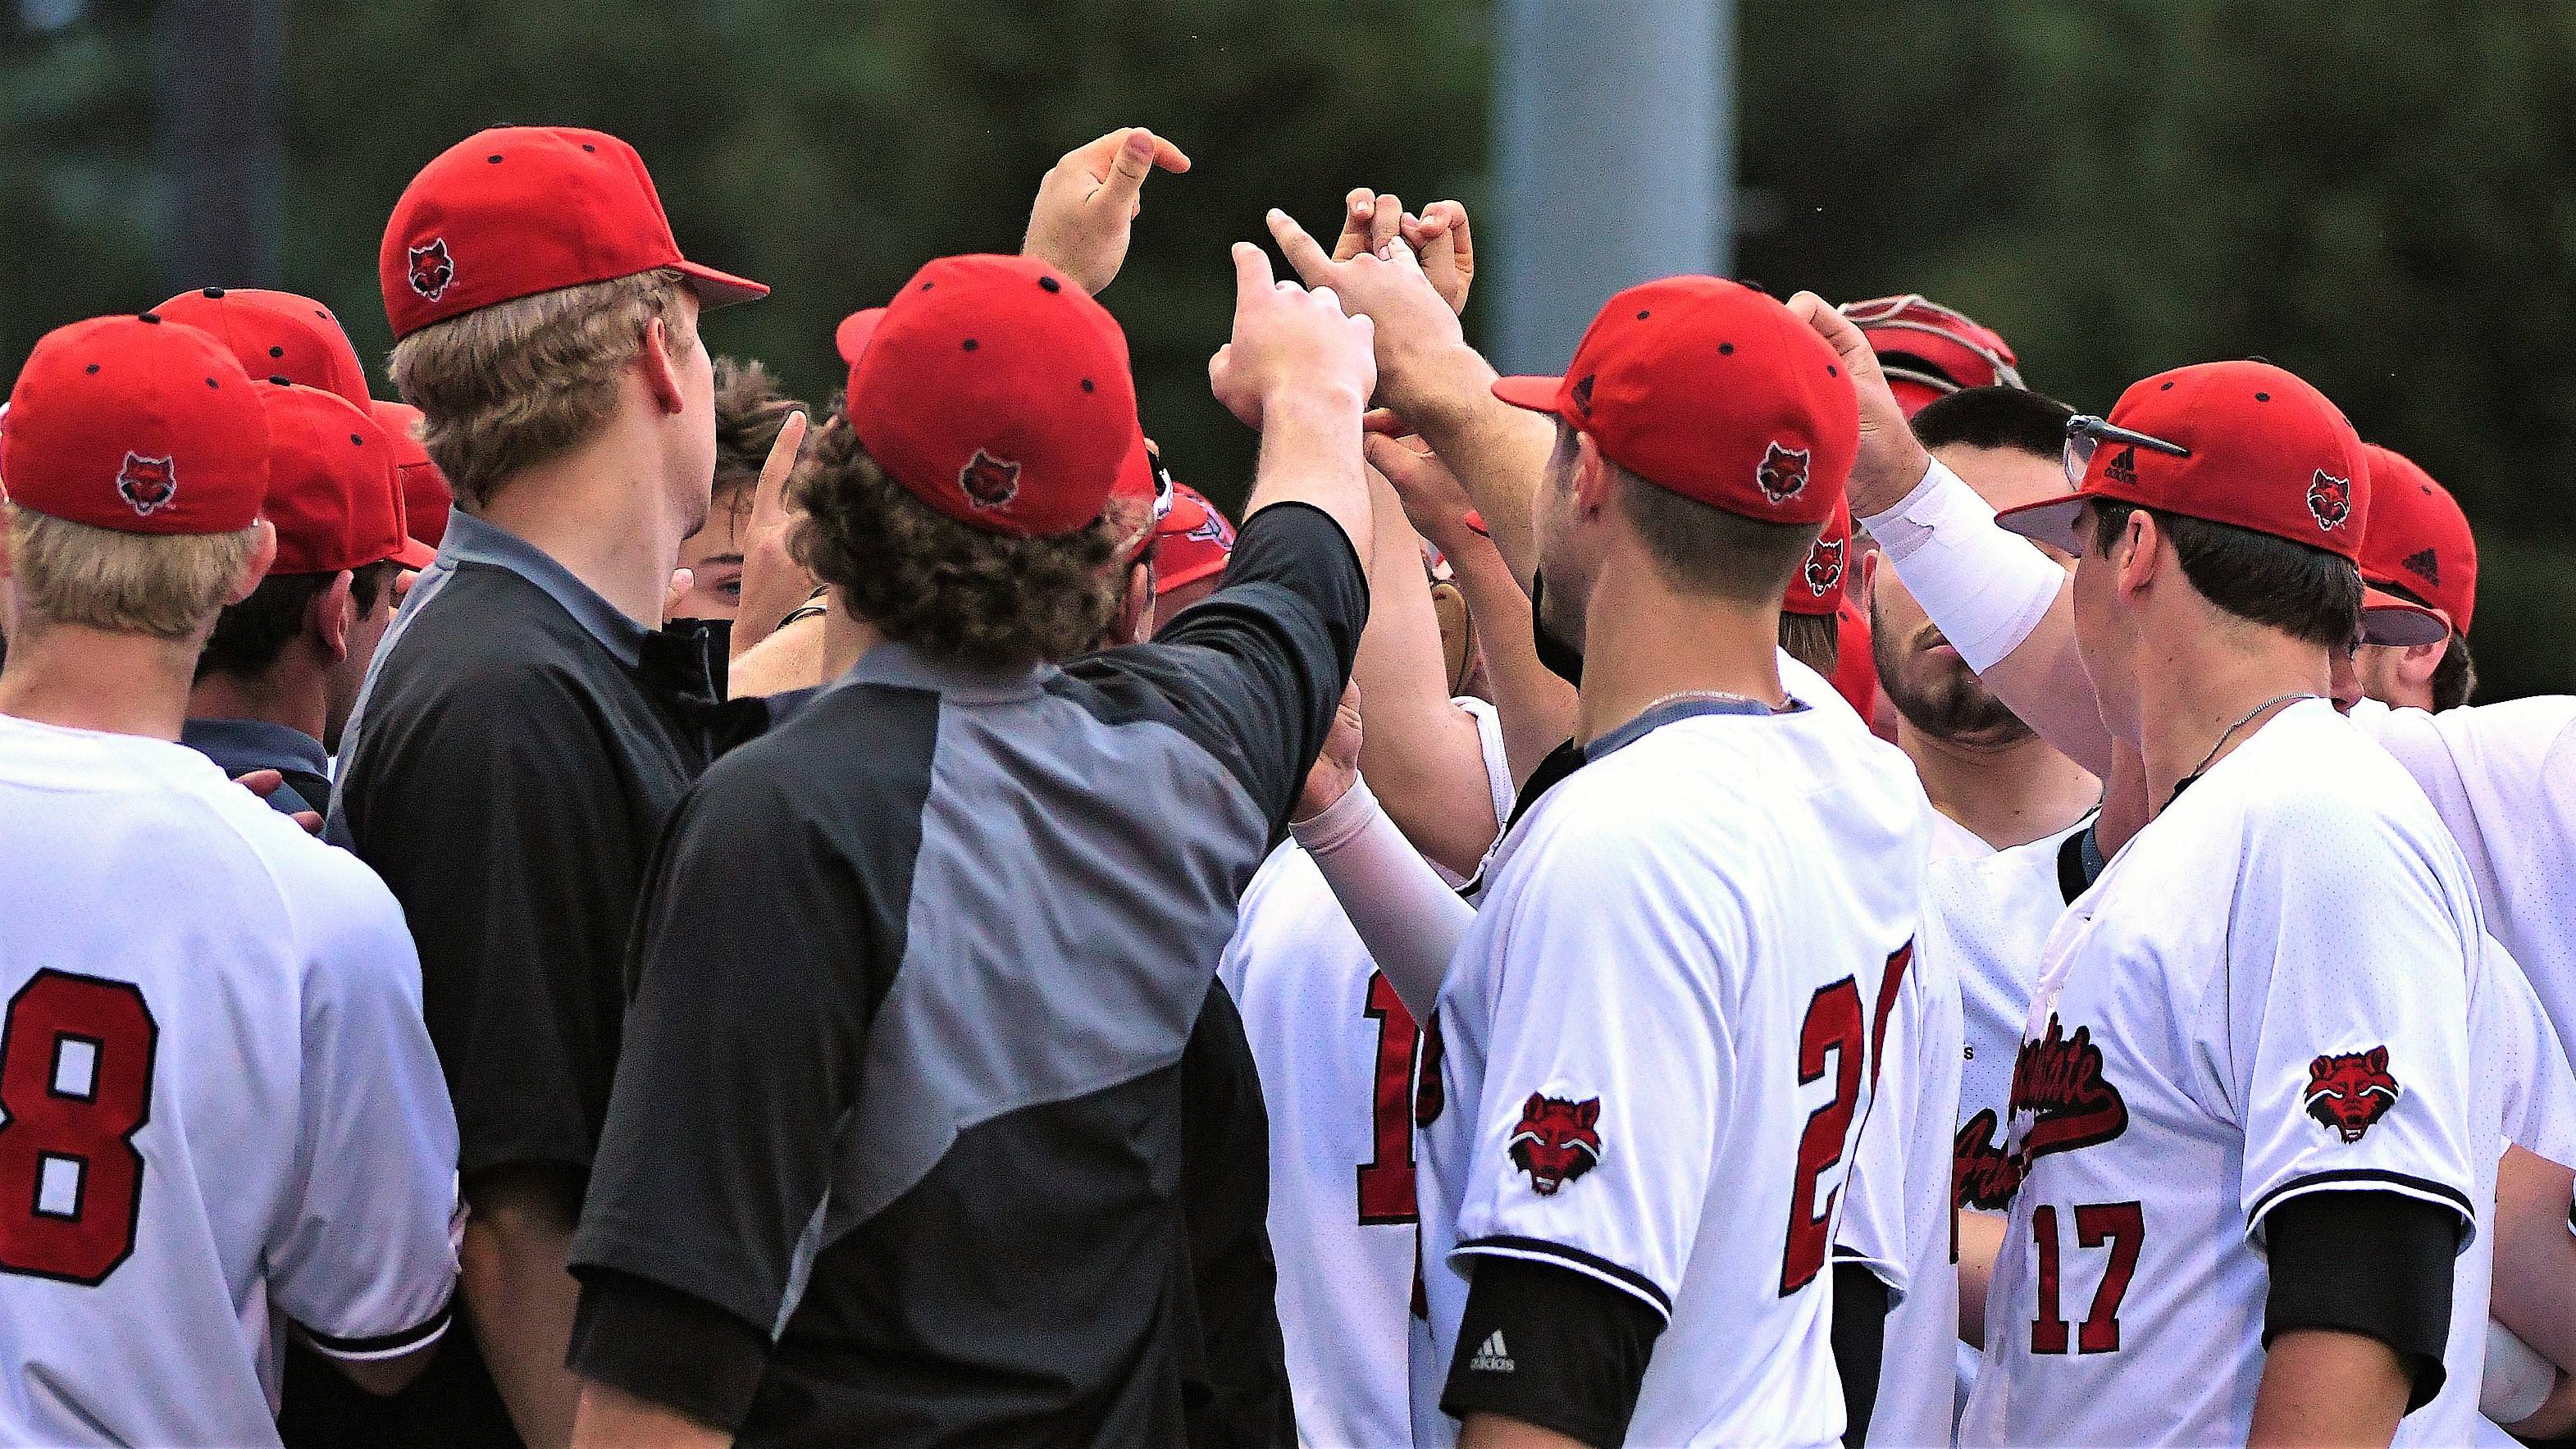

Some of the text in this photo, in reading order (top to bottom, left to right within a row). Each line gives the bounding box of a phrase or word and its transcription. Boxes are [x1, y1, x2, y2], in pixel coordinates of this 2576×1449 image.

[0, 966, 160, 1287] 8
[1356, 969, 1422, 1226] 1
[1469, 1355, 1516, 1374] adidas
[2031, 1201, 2145, 1355] 17
